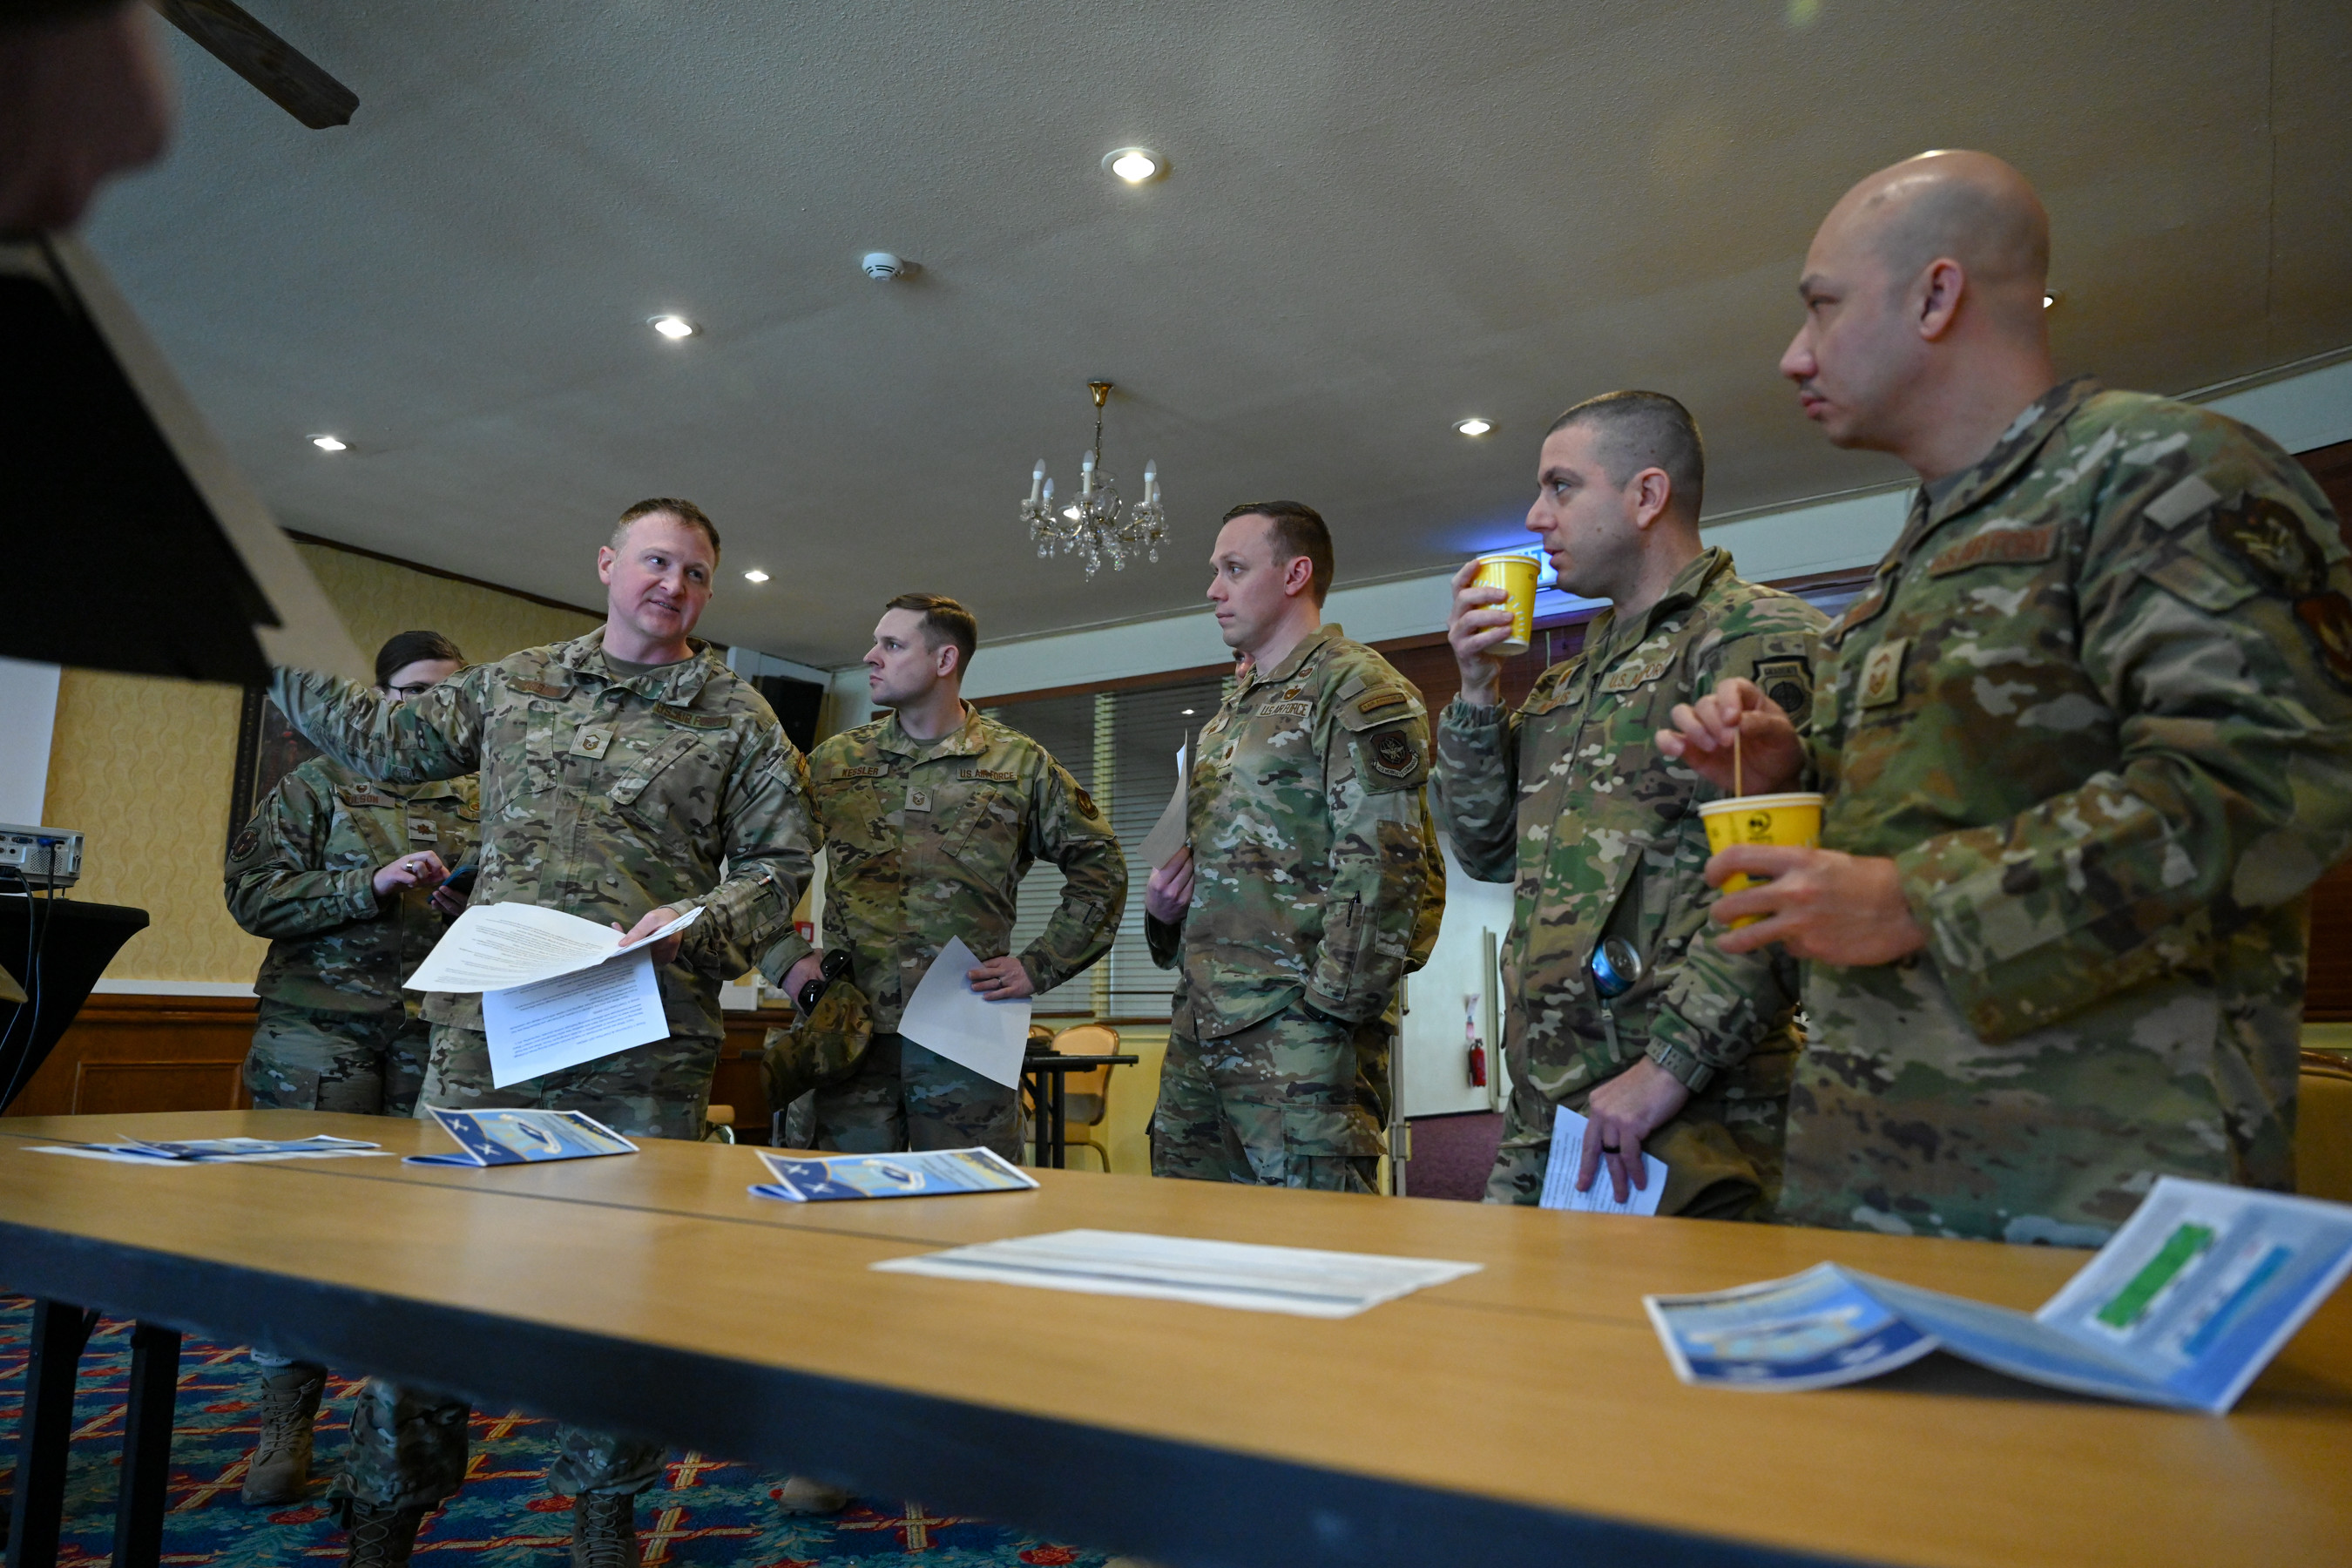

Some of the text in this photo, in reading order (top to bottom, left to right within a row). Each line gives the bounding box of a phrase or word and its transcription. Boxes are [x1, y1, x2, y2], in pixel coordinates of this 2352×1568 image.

[1281, 702, 1308, 717] FORCE
[841, 766, 879, 778] KESSLER
[990, 769, 1014, 781] FORCE
